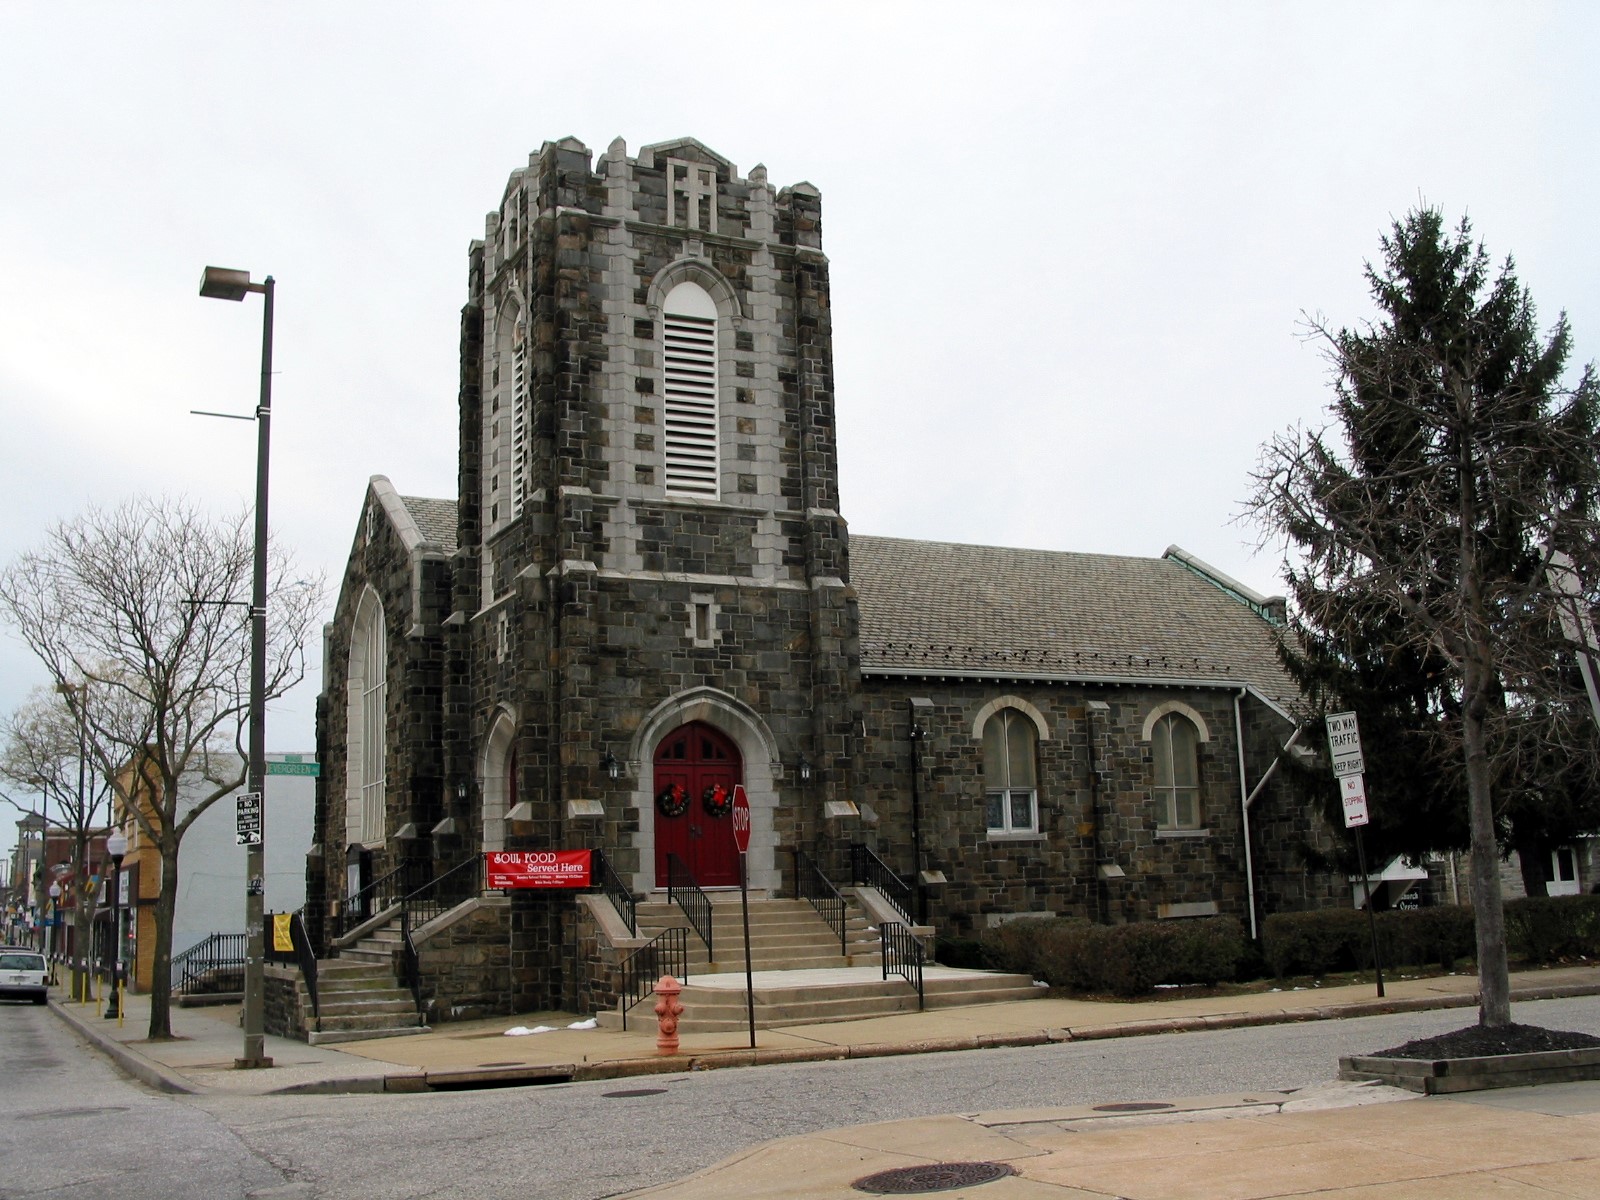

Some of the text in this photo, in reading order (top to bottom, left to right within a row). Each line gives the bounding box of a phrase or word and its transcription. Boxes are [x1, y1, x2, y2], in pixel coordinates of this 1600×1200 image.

[1327, 718, 1356, 733] TWO WAY
[1330, 732, 1358, 747] TRAFFIC
[1334, 759, 1362, 772] KEEP RIGHT
[1347, 781, 1356, 790] NO
[1344, 795, 1364, 807] STOPPING
[238, 807, 258, 815] PARKING
[733, 806, 749, 831] STOP
[494, 853, 556, 864] SOUL FOOD
[527, 863, 583, 873] Served Here
